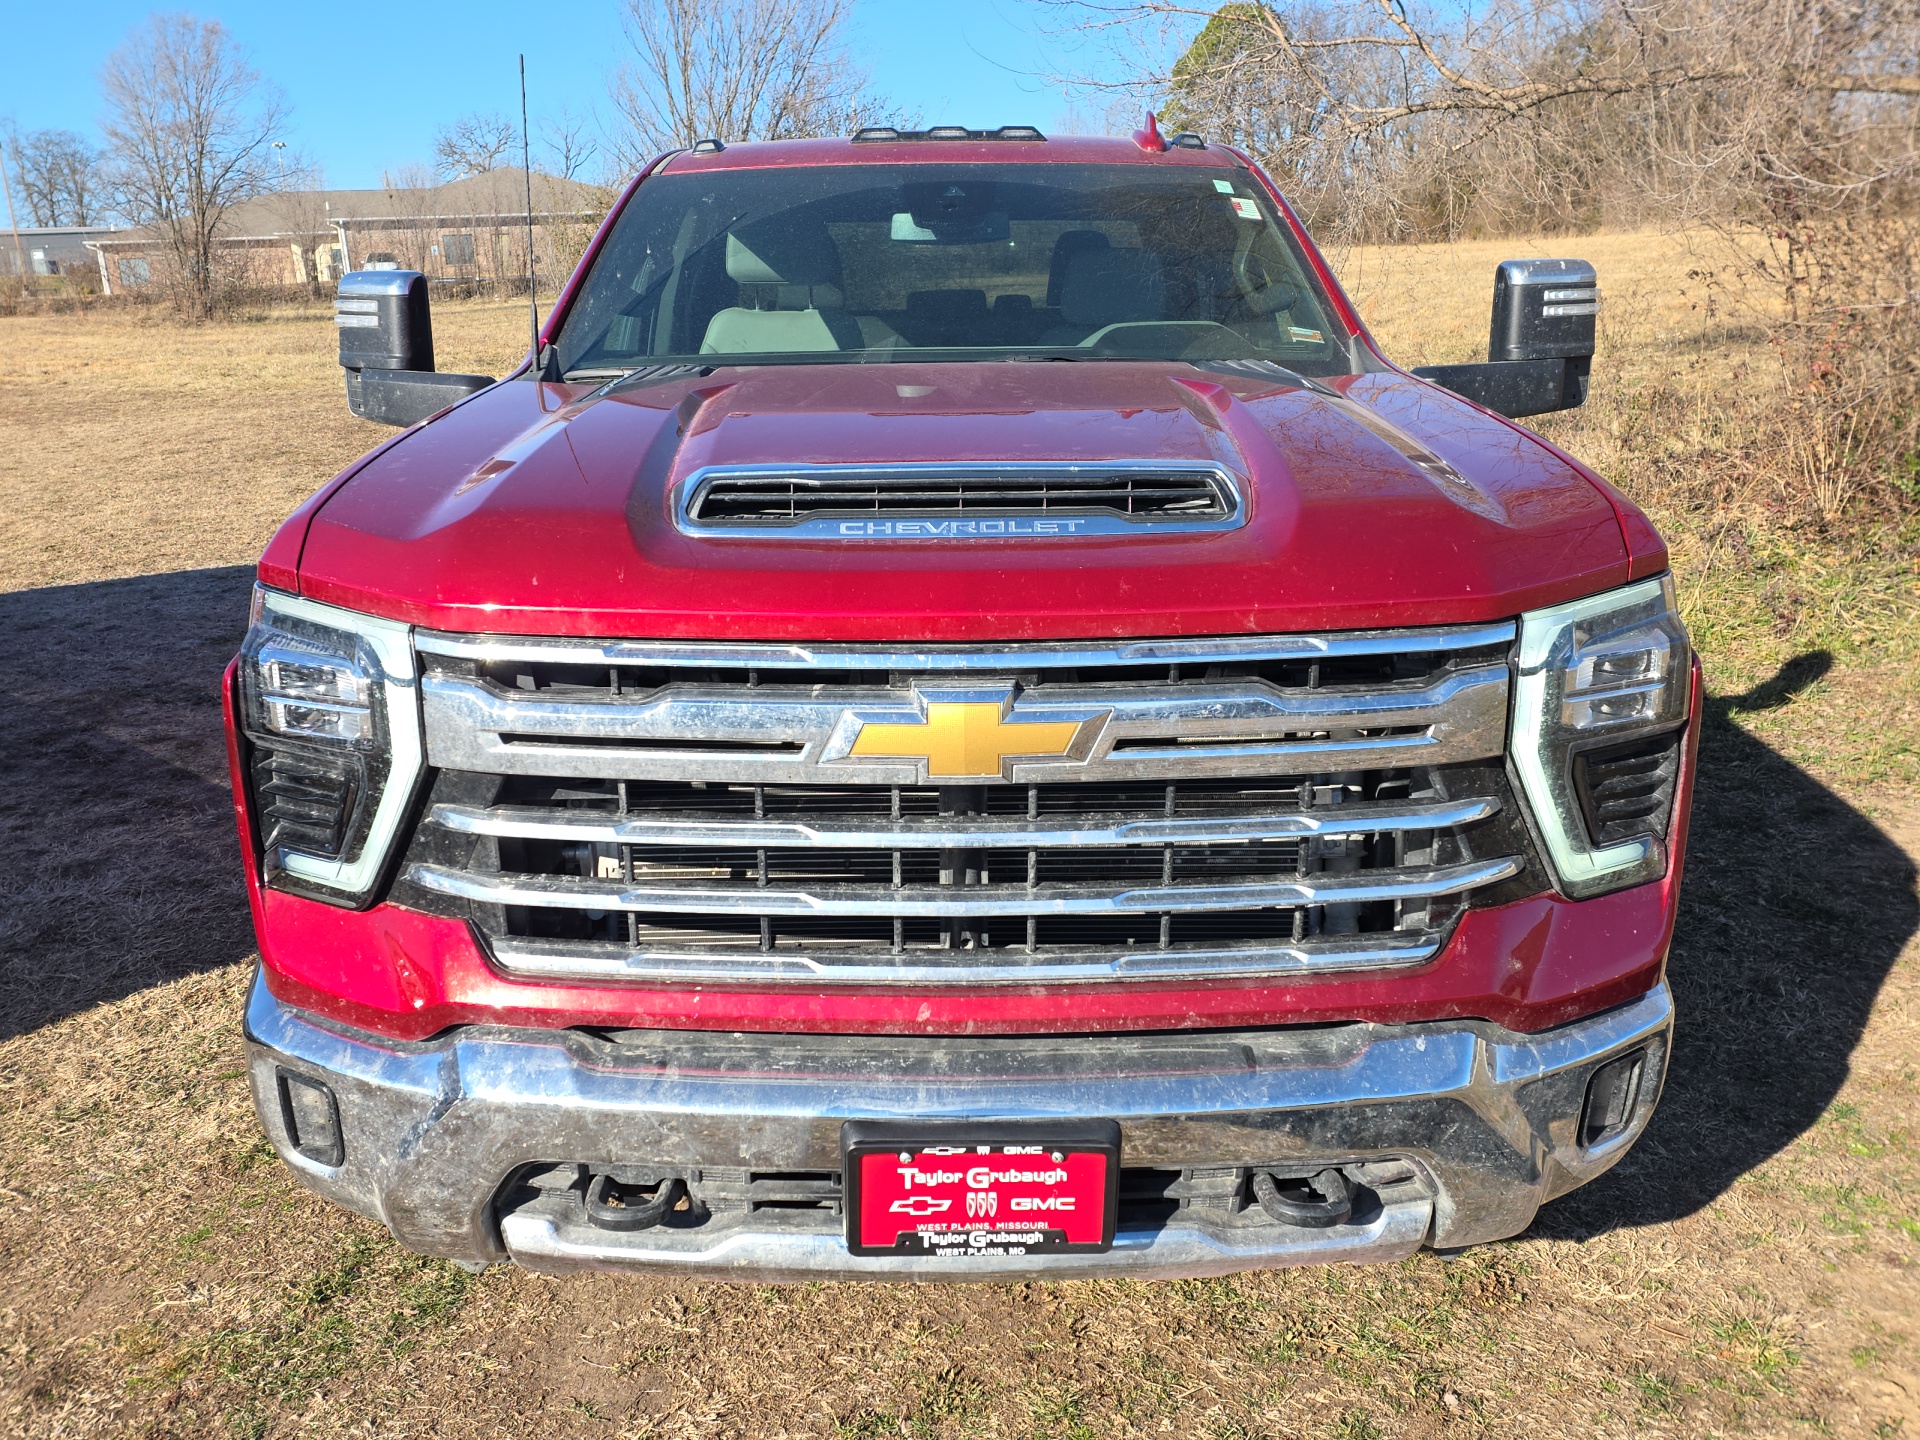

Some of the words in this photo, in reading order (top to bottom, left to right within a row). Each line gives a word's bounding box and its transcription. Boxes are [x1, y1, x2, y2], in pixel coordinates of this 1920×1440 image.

[839, 519, 1085, 534] CHEVROLET
[1003, 1146, 1043, 1155] GMC
[897, 1168, 963, 1189] Taylor
[966, 1167, 1067, 1189] Grubaugh
[1010, 1197, 1076, 1210] GMC
[917, 1223, 948, 1231] WEST
[951, 1222, 993, 1231] PLAINS,
[996, 1222, 1048, 1230] MISSOURI
[918, 1231, 967, 1248] Taylor
[969, 1231, 1044, 1247] Grubaugh
[936, 1248, 965, 1256] WEST
[967, 1247, 1006, 1256] PLAINS,
[1009, 1247, 1026, 1255] MO
